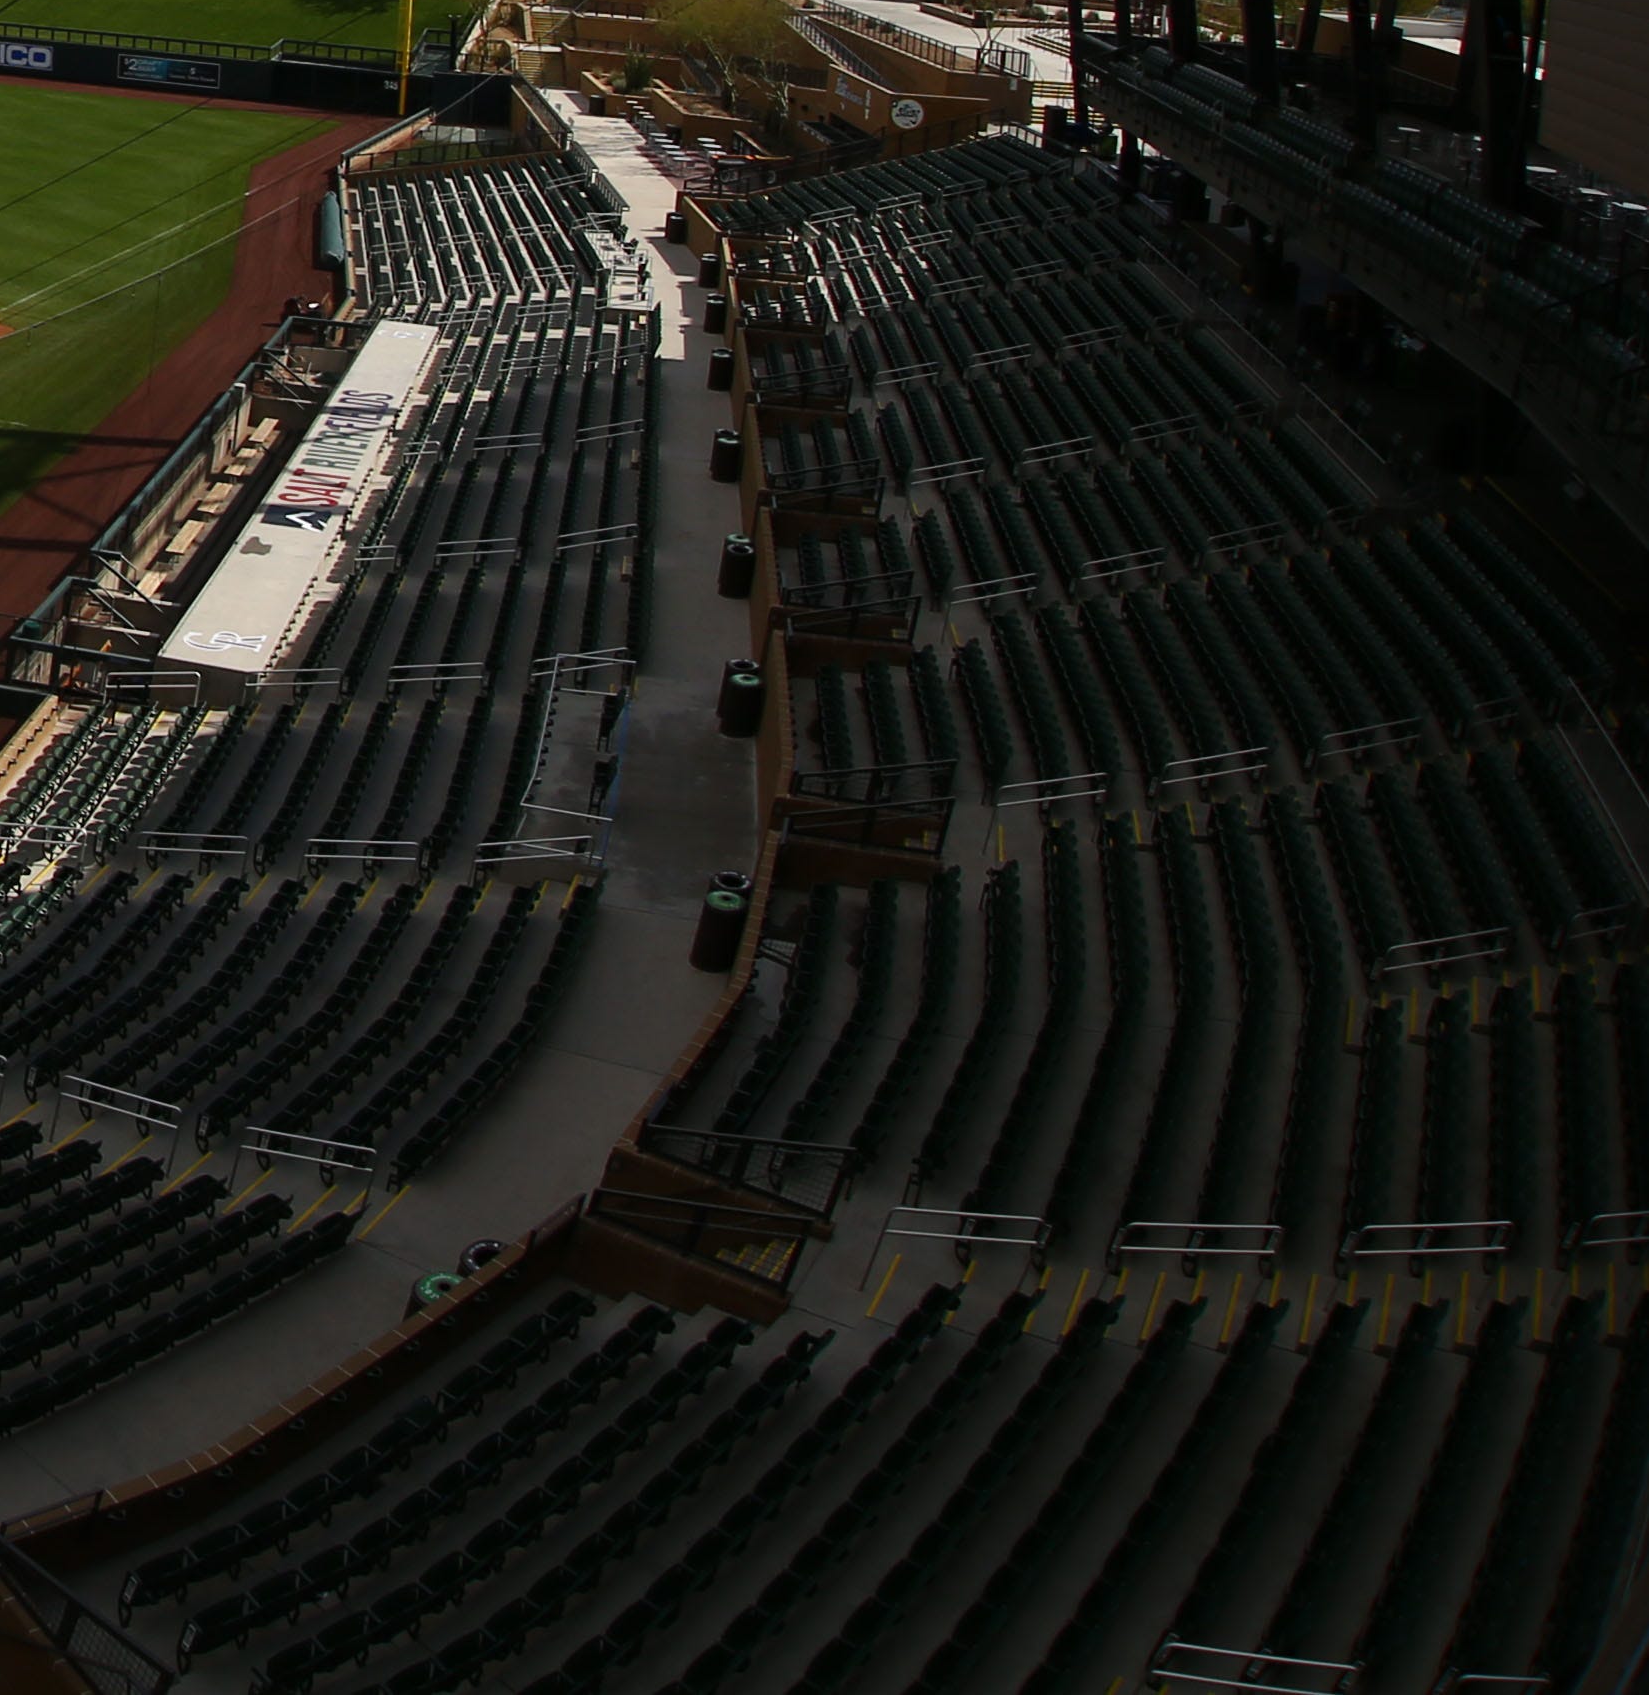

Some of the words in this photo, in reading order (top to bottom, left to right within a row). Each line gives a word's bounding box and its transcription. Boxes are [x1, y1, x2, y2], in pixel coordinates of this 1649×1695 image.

[324, 390, 394, 432] FIELDS
[301, 430, 374, 471] RIVER
[278, 468, 351, 507] SALT
